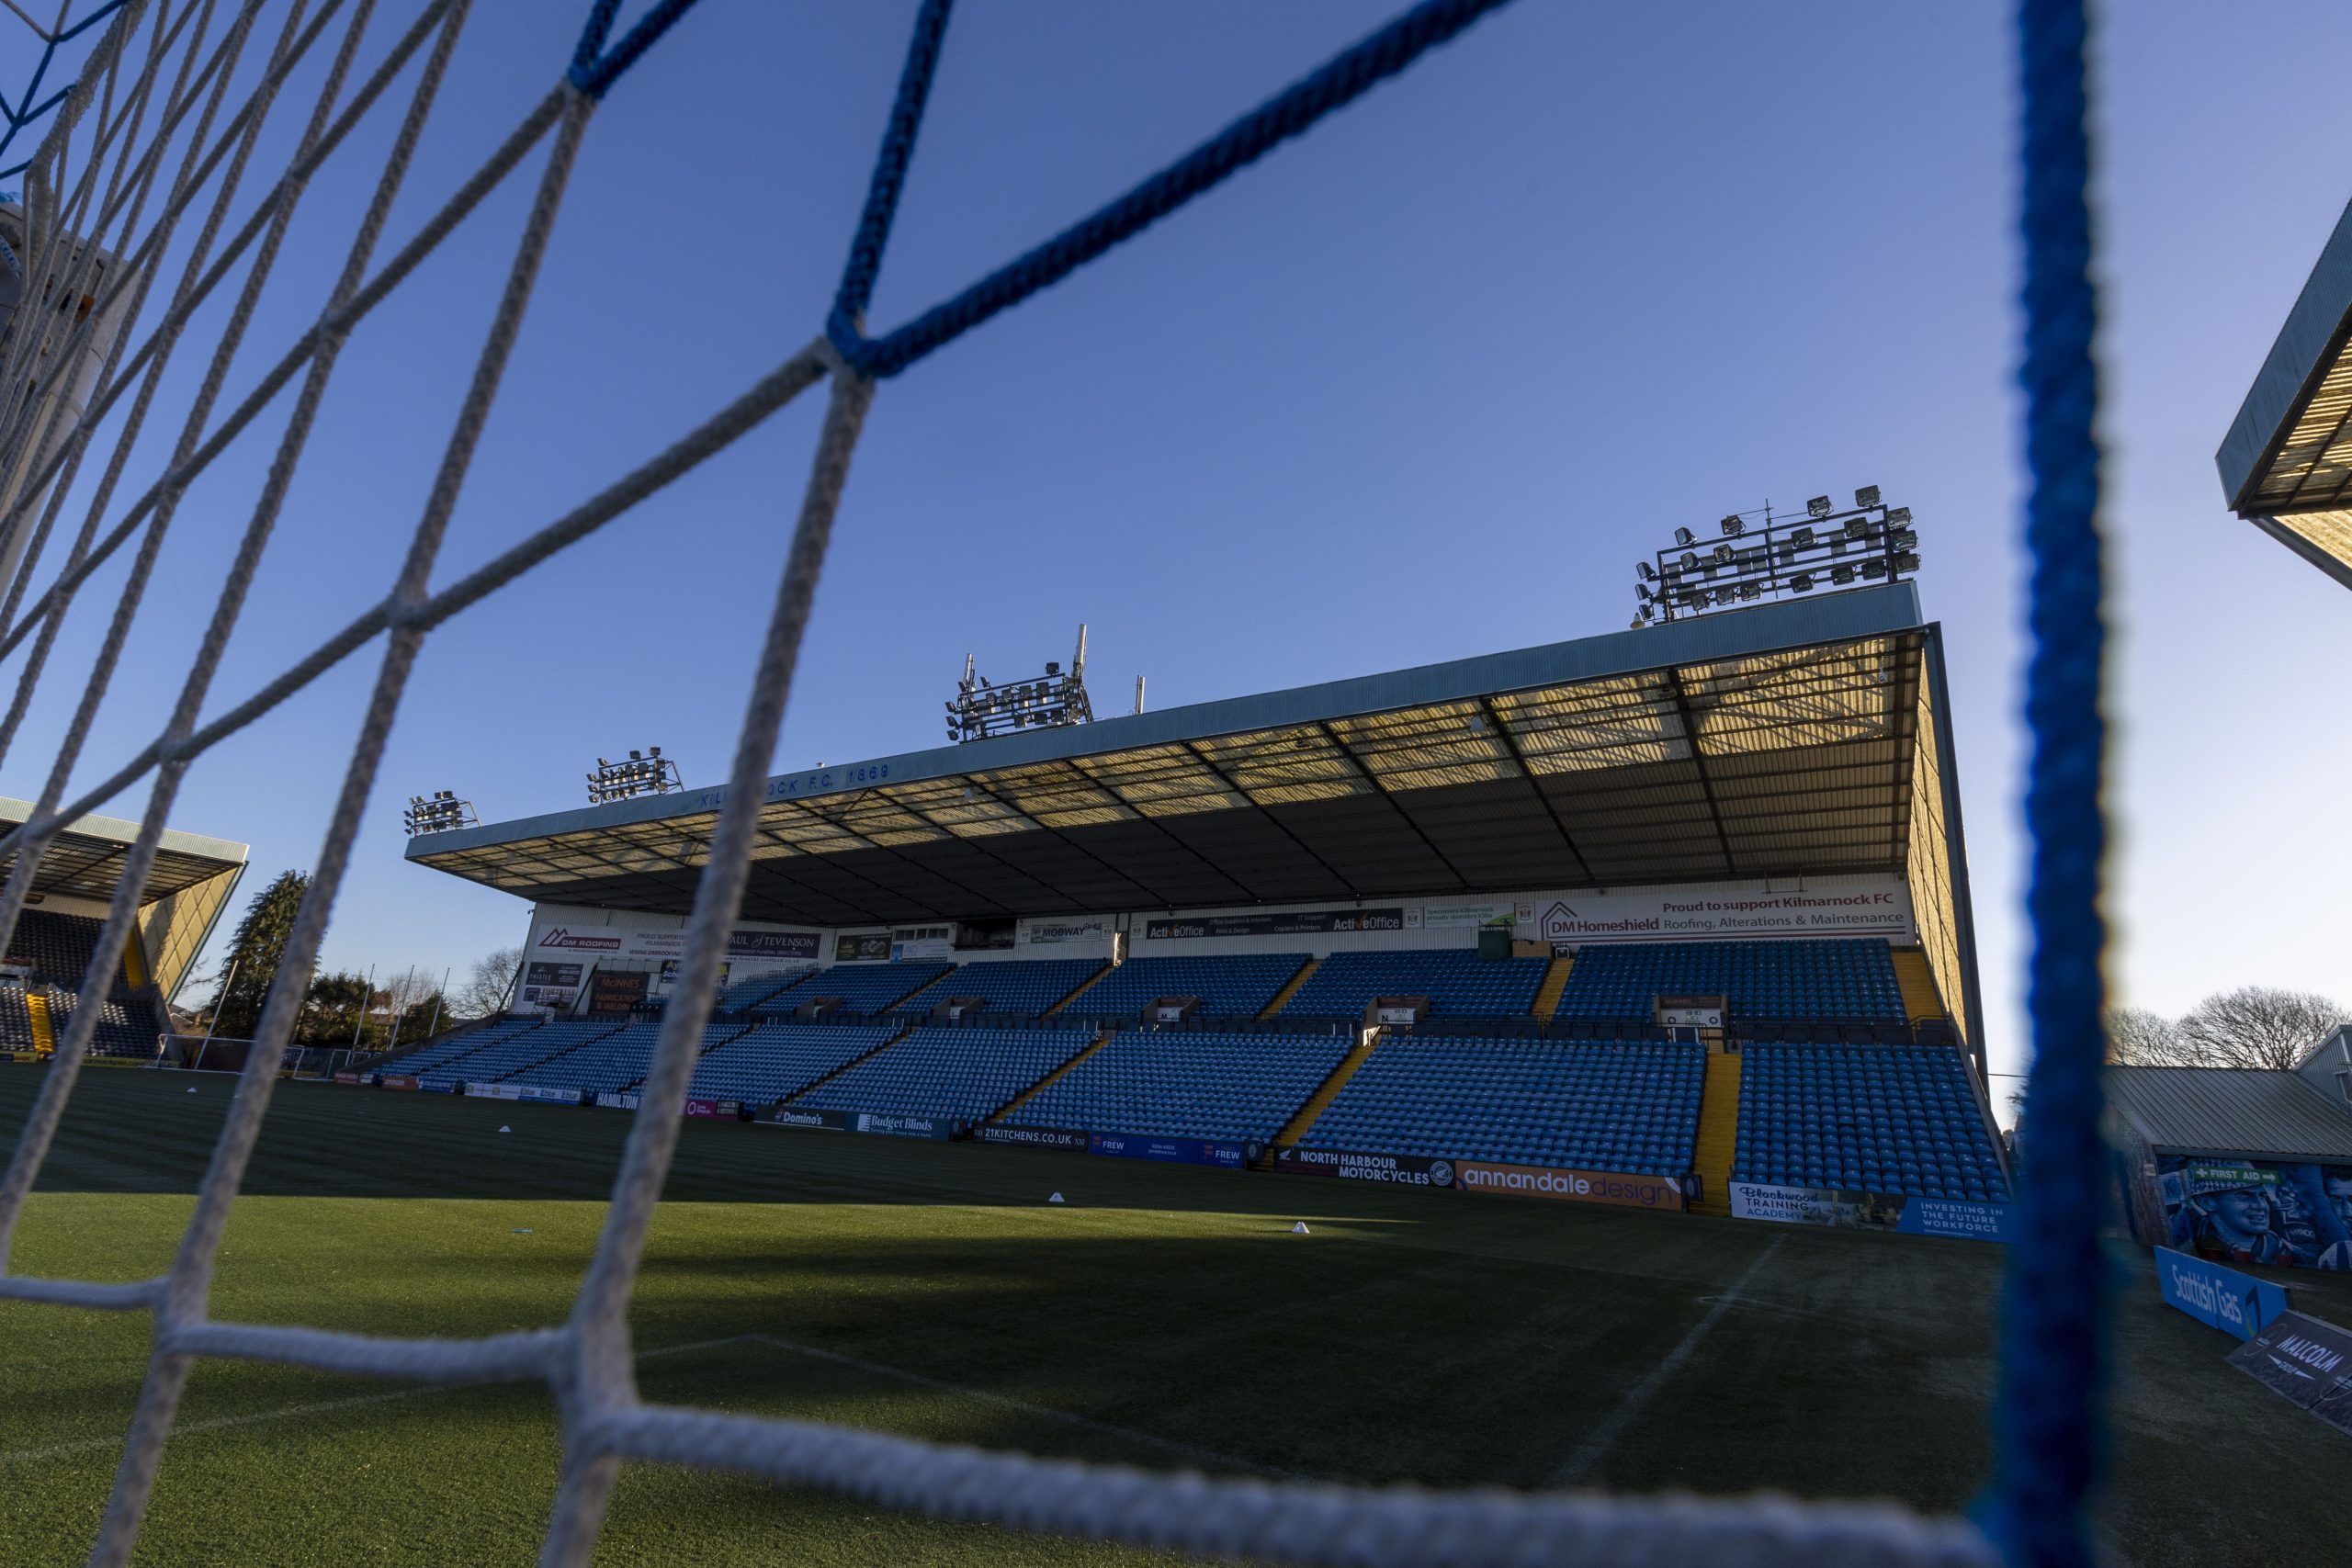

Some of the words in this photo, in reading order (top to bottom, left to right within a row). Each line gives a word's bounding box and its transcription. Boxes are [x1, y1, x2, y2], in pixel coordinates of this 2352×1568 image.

[701, 780, 797, 806] KILOCK
[849, 764, 888, 782] 1869
[1663, 902, 1703, 912] Proud
[1707, 902, 1721, 910] to
[1724, 898, 1781, 912] support
[1783, 895, 1870, 908] Kilmarnock
[1874, 893, 1894, 904] FC
[1552, 921, 1575, 932] DM
[1577, 918, 1659, 931] Homeshield
[1664, 919, 1716, 931] Roofing,
[1720, 915, 1791, 927] Alterations
[1796, 915, 1805, 925] &
[1811, 912, 1905, 924] Maintenance
[596, 1092, 639, 1110] HAMILTON
[783, 1111, 822, 1125] Domino's
[872, 1114, 903, 1130] Budget
[905, 1117, 933, 1131] Blinds
[985, 1128, 1071, 1145] 21KITCHENS.CO.UK
[1102, 1141, 1124, 1149] FREW
[1216, 1150, 1239, 1159] FREW
[1300, 1151, 1338, 1164] NORTH
[1340, 1154, 1396, 1169] HARBOUR
[1339, 1167, 1430, 1185] MOTORCYCLES
[2210, 1168, 2237, 1179] FIRST
[2243, 1172, 2259, 1180] AID
[1739, 1187, 1818, 1202] Blackwood
[1746, 1198, 1809, 1211] TRAINING
[1920, 1202, 1985, 1214] INVESTING
[1990, 1208, 2003, 1216] IN
[1747, 1208, 1802, 1219] ACADEMY
[1922, 1211, 1944, 1219] THE
[1949, 1213, 1996, 1224] FUTURE
[1923, 1219, 1999, 1233] WORKFORCE
[2172, 1264, 2217, 1315] Scottish
[2215, 1279, 2242, 1325] Gas
[2276, 1334, 2345, 1372] MALCOLM
